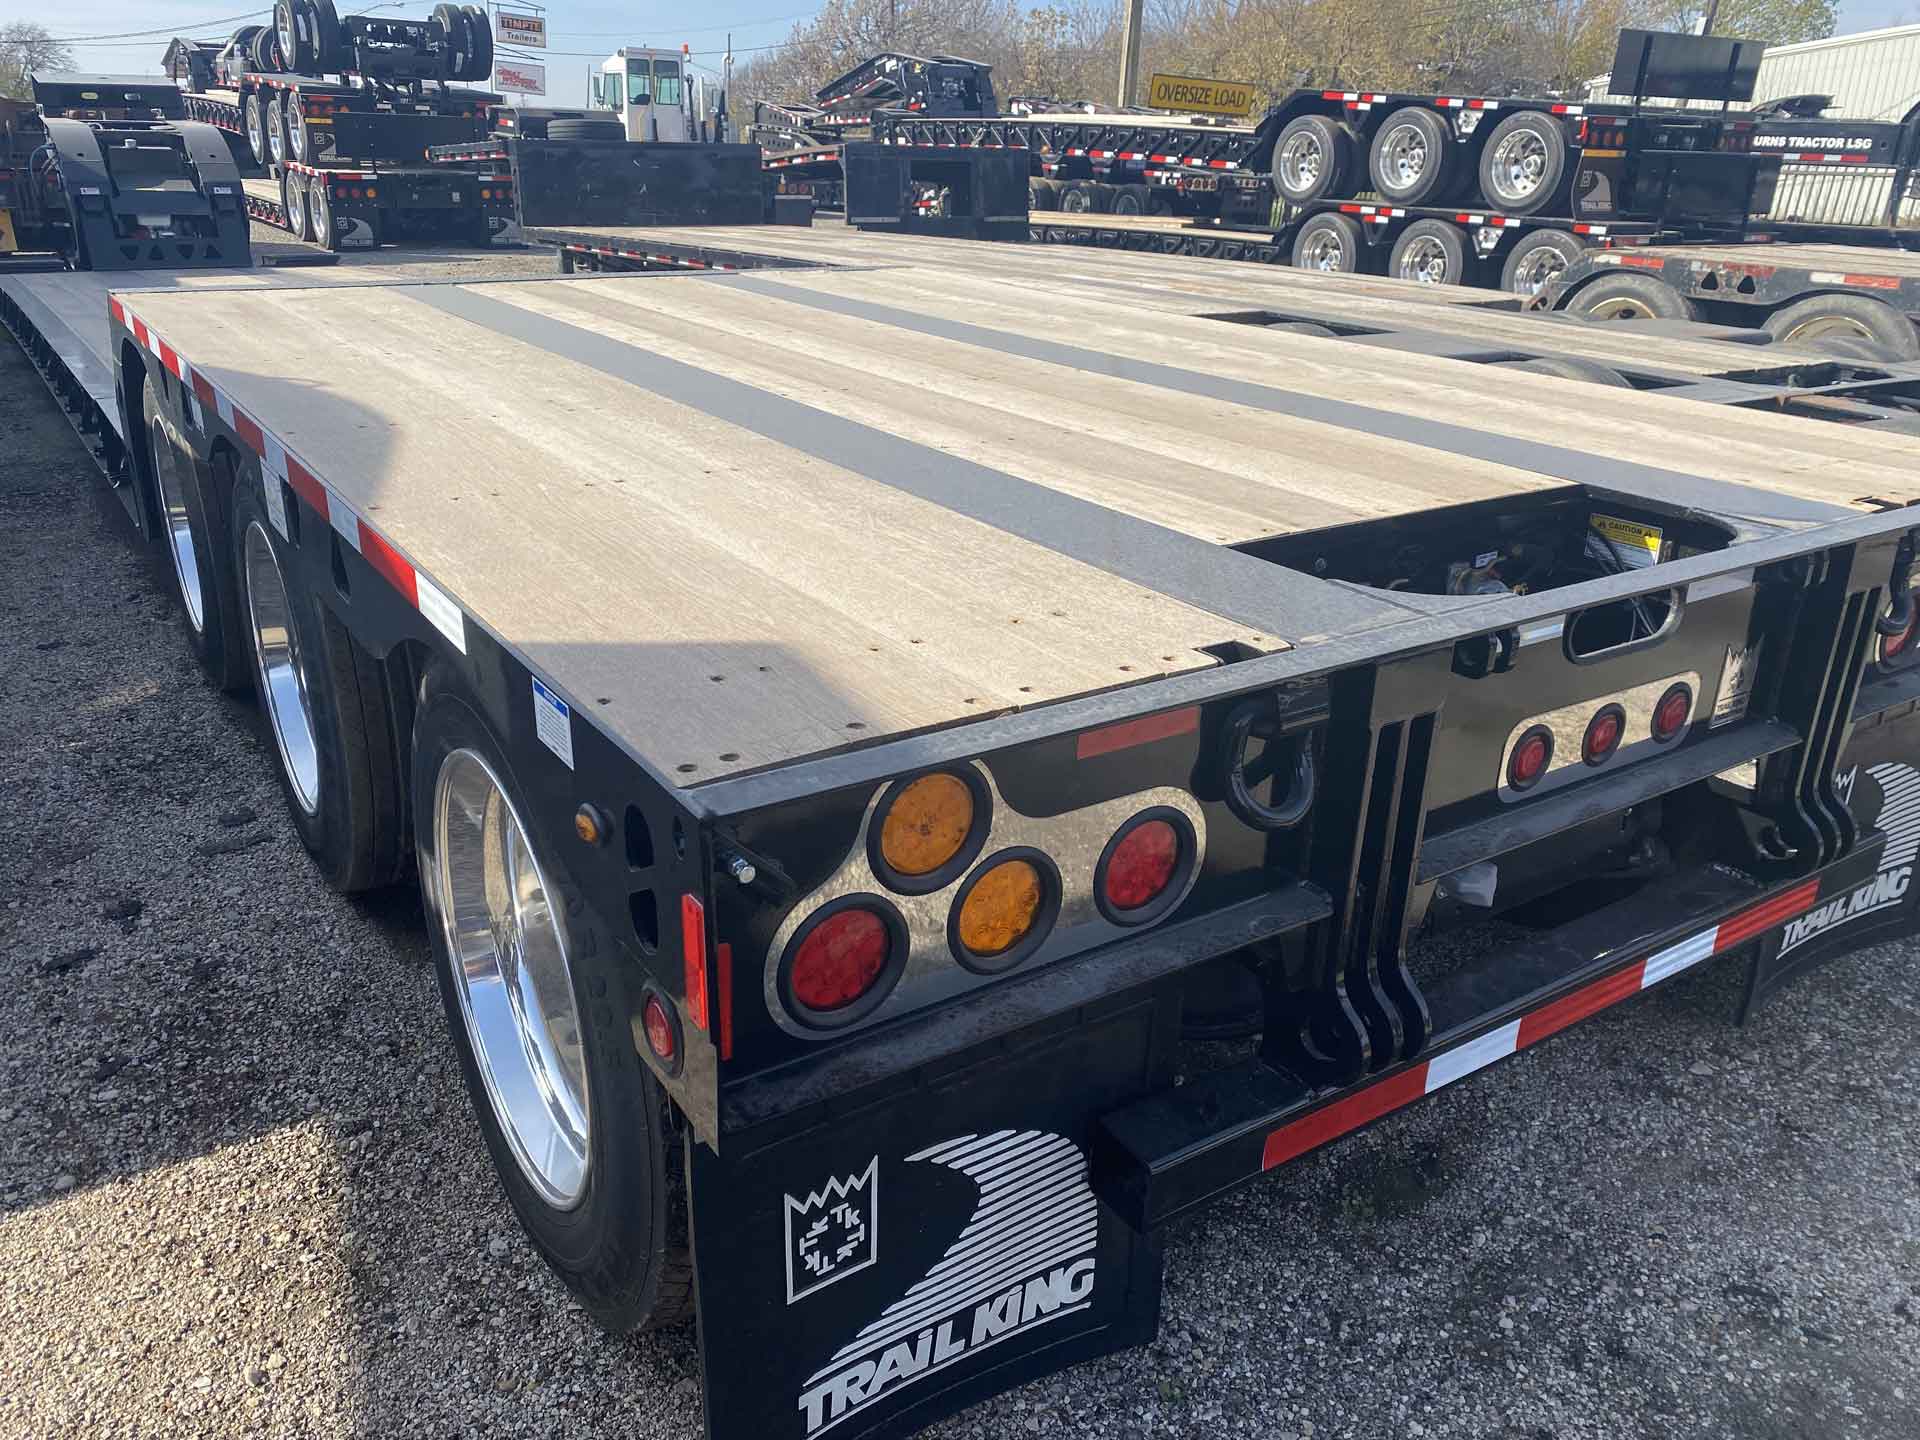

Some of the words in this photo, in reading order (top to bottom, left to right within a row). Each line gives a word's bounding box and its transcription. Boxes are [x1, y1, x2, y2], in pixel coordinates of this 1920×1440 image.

[507, 31, 537, 43] Trailers
[1157, 82, 1213, 105] OVERSIZE
[1214, 88, 1246, 107] LOAD
[1753, 135, 1786, 147] URNS
[1788, 136, 1845, 149] TRACTOR
[1846, 138, 1873, 149] LSG
[1608, 520, 1642, 535] CAUTION
